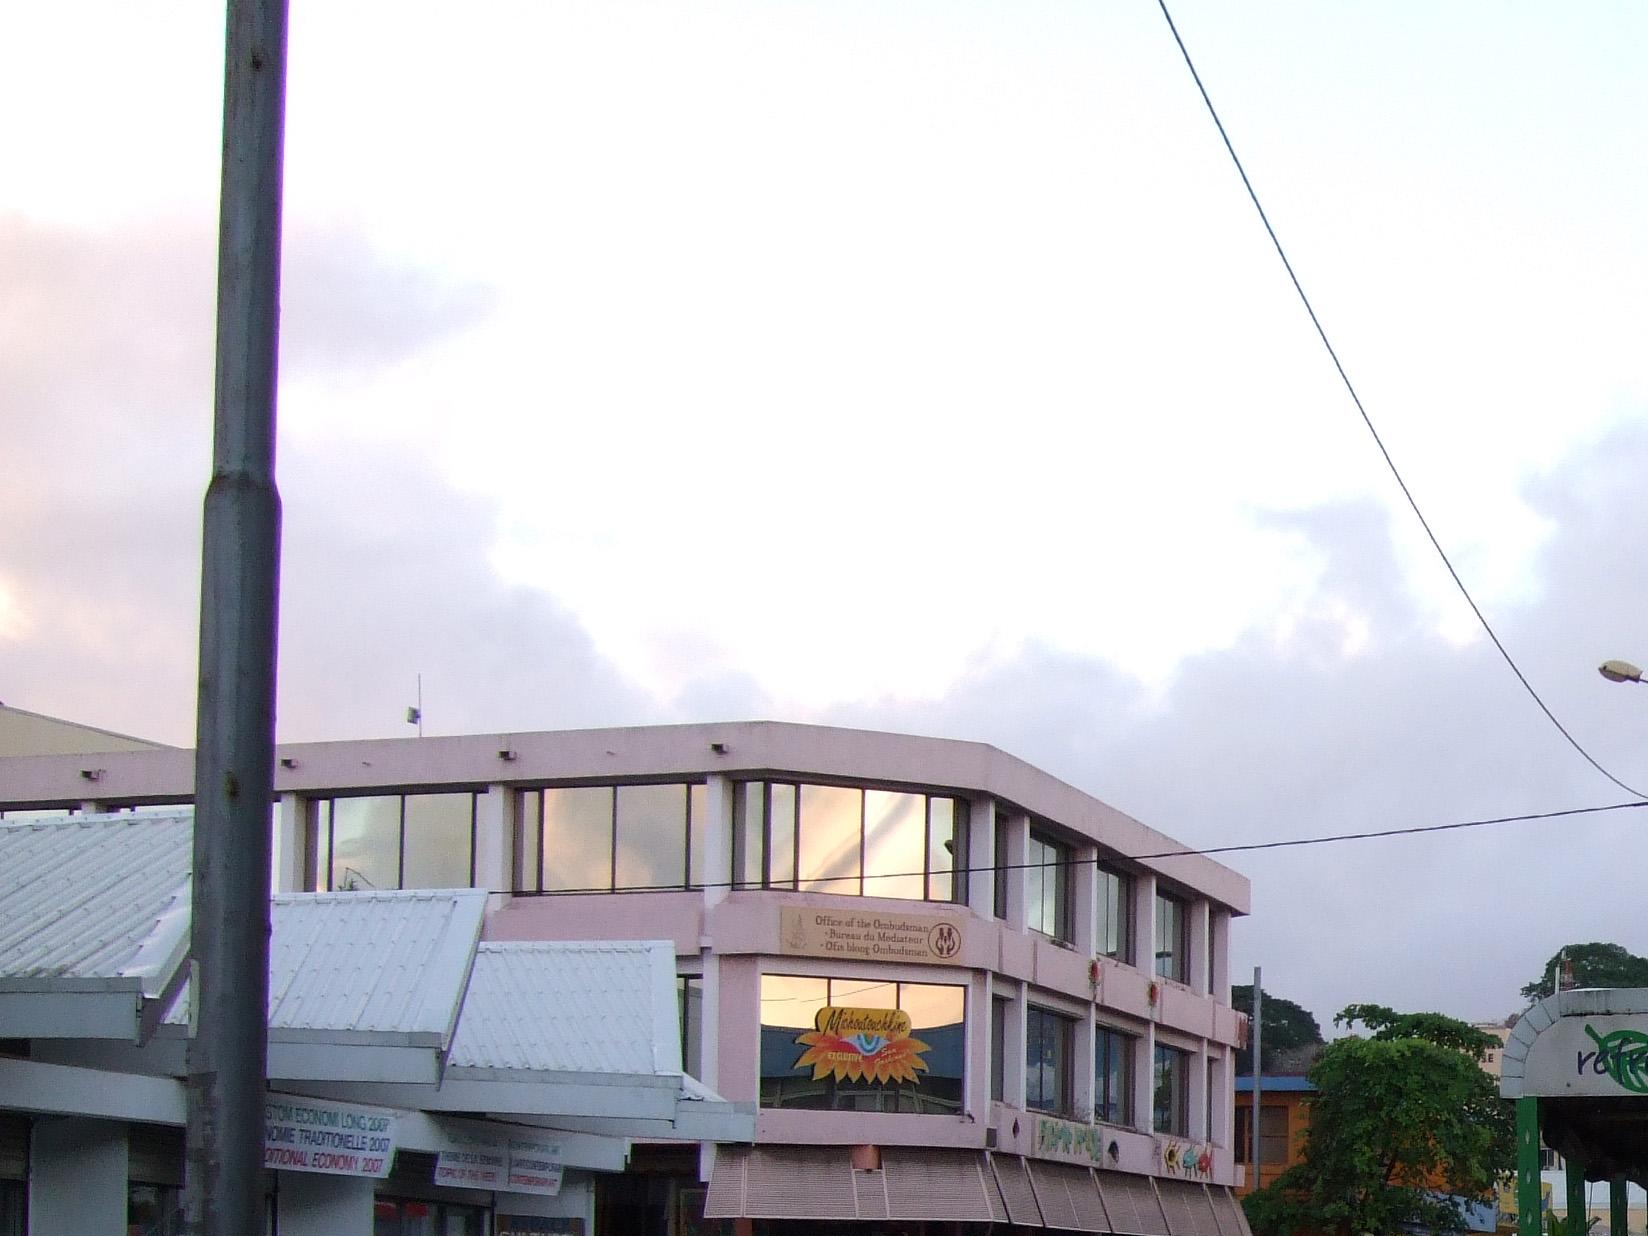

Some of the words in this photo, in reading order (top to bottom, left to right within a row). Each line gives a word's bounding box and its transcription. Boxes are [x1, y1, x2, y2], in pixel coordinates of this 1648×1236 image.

[814, 914, 843, 929] Office
[845, 916, 856, 928] of
[857, 918, 872, 929] the
[873, 918, 930, 934] Ombudsman
[829, 929, 862, 942] Bureau
[863, 931, 876, 942] du
[872, 944, 929, 958] Ombudsman
[264, 1103, 293, 1122] STOM
[341, 1111, 366, 1130] LONG
[368, 1116, 391, 1132] 2007
[264, 1124, 295, 1144] NOMIE
[369, 1137, 391, 1153] 2007
[264, 1147, 309, 1167] DITIONAL
[311, 1152, 359, 1171] ECONOMY
[361, 1157, 384, 1173] 2007
